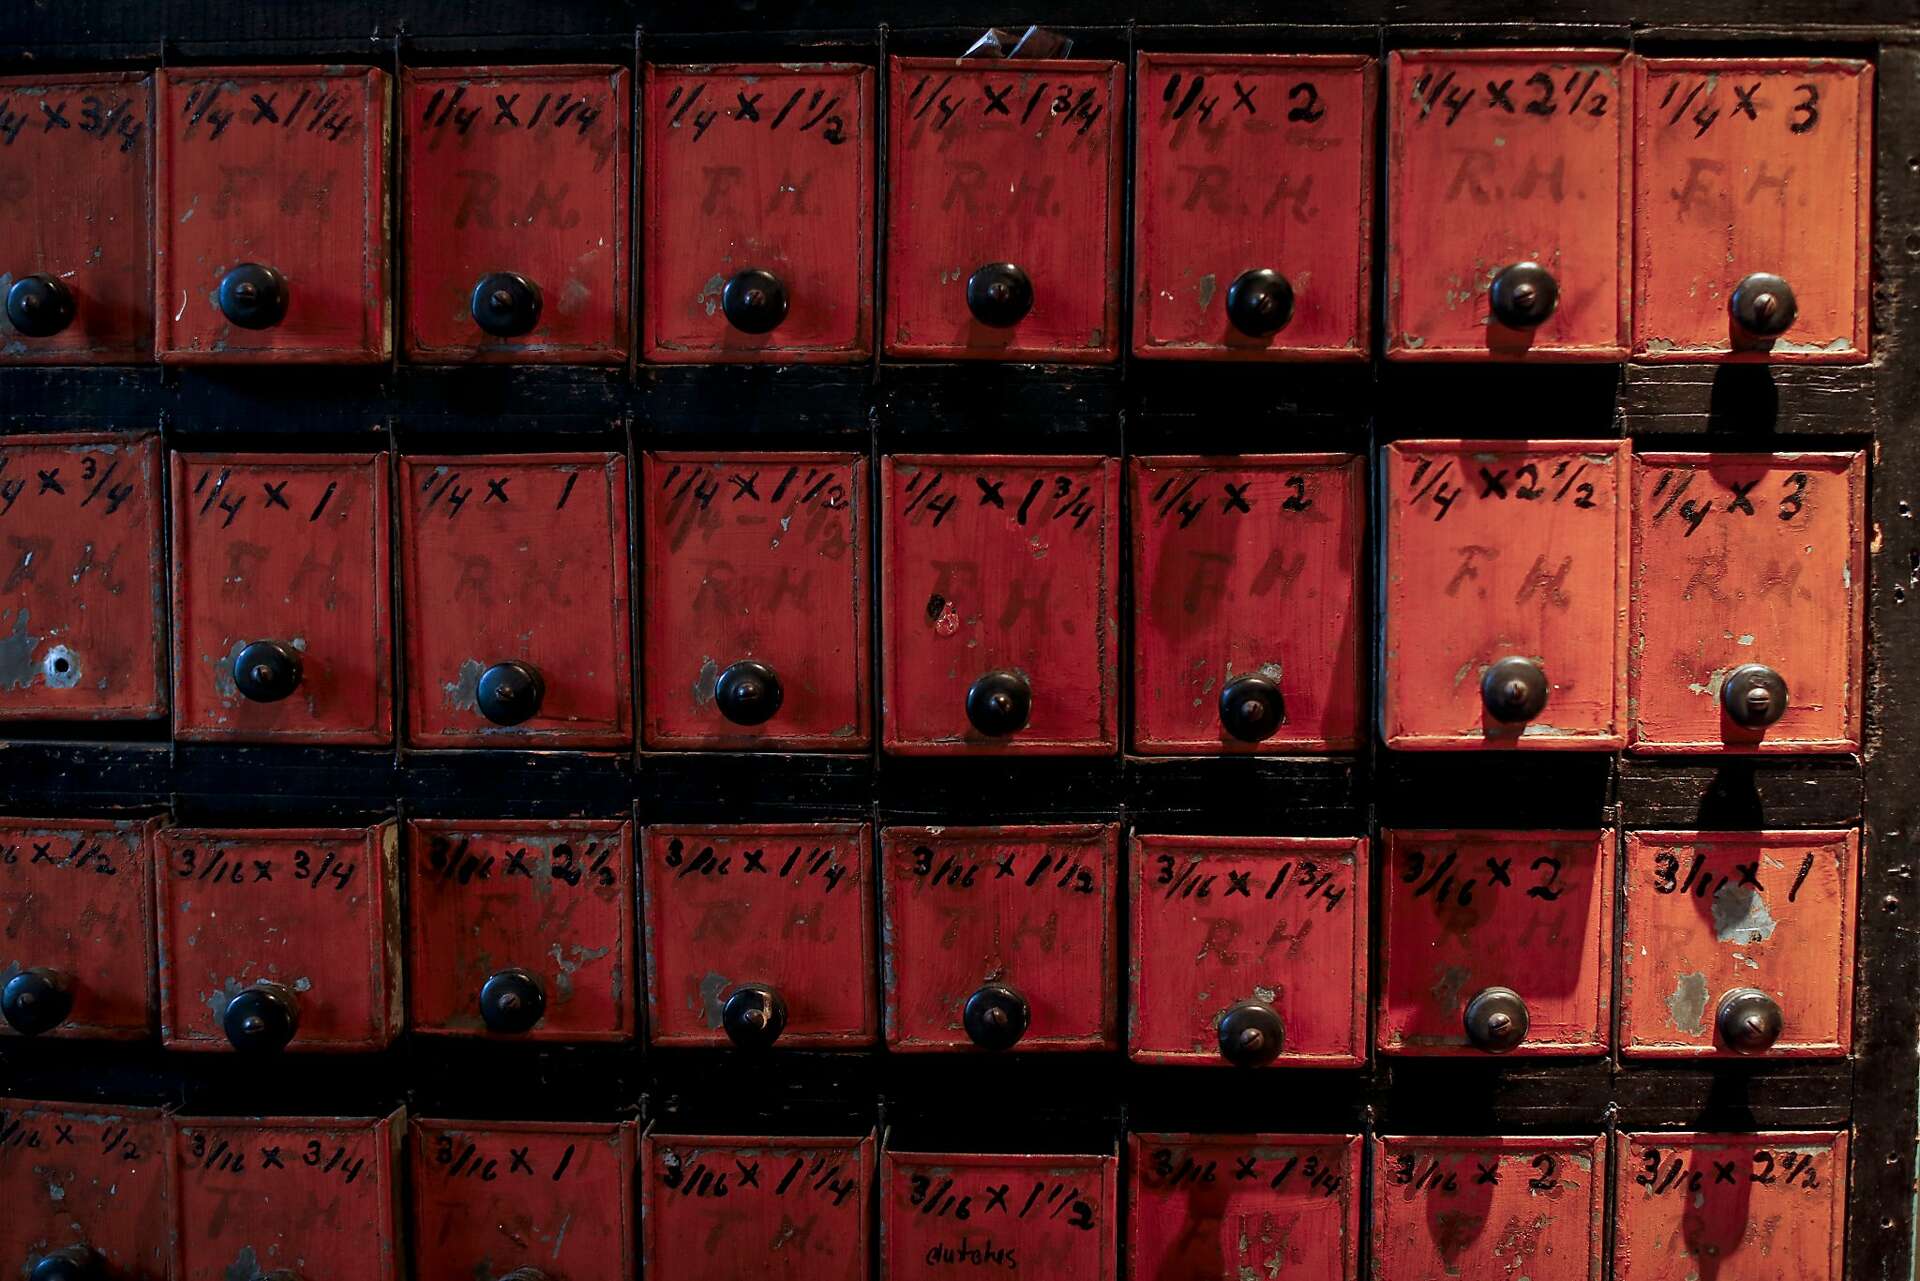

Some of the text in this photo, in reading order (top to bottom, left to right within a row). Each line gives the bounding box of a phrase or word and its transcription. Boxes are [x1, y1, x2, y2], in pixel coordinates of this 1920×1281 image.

[183, 86, 234, 141] 1/4
[422, 87, 482, 135] 1/4
[665, 83, 718, 143] 1/4
[909, 75, 965, 131] 1/4
[1163, 73, 1219, 125] 1/4
[1287, 83, 1325, 123] 2
[1413, 71, 1475, 126] 1/4
[1660, 81, 1719, 139] 1/4
[1790, 84, 1820, 134] 3
[80, 456, 134, 515] 3/4
[194, 468, 246, 529] 1/4
[308, 481, 337, 522] 1
[421, 471, 472, 520] 1/4
[556, 472, 579, 511] 1
[662, 466, 719, 511] 1/4
[904, 472, 957, 527] 1/4
[1154, 477, 1205, 528] 1/4
[1281, 476, 1312, 511] 2
[1409, 456, 1461, 521] 1/4
[1515, 463, 1545, 501] 2
[1651, 471, 1712, 538] 1/4
[1778, 474, 1809, 520] 3
[179, 849, 244, 884] 3/16
[294, 850, 355, 890] 3/4
[1156, 855, 1216, 900] 3/16
[1402, 851, 1476, 906] 3/16
[1527, 856, 1562, 900] 2
[1788, 852, 1814, 902] 1
[101, 1126, 140, 1160] 1/2
[191, 1133, 245, 1174] 3/16
[303, 1141, 365, 1184] 3/4
[552, 1144, 574, 1181] 1
[1394, 1155, 1457, 1192] 3/16
[1529, 1155, 1558, 1192] 2
[1636, 1148, 1703, 1195] 3/16
[910, 1176, 971, 1220] 3/16
